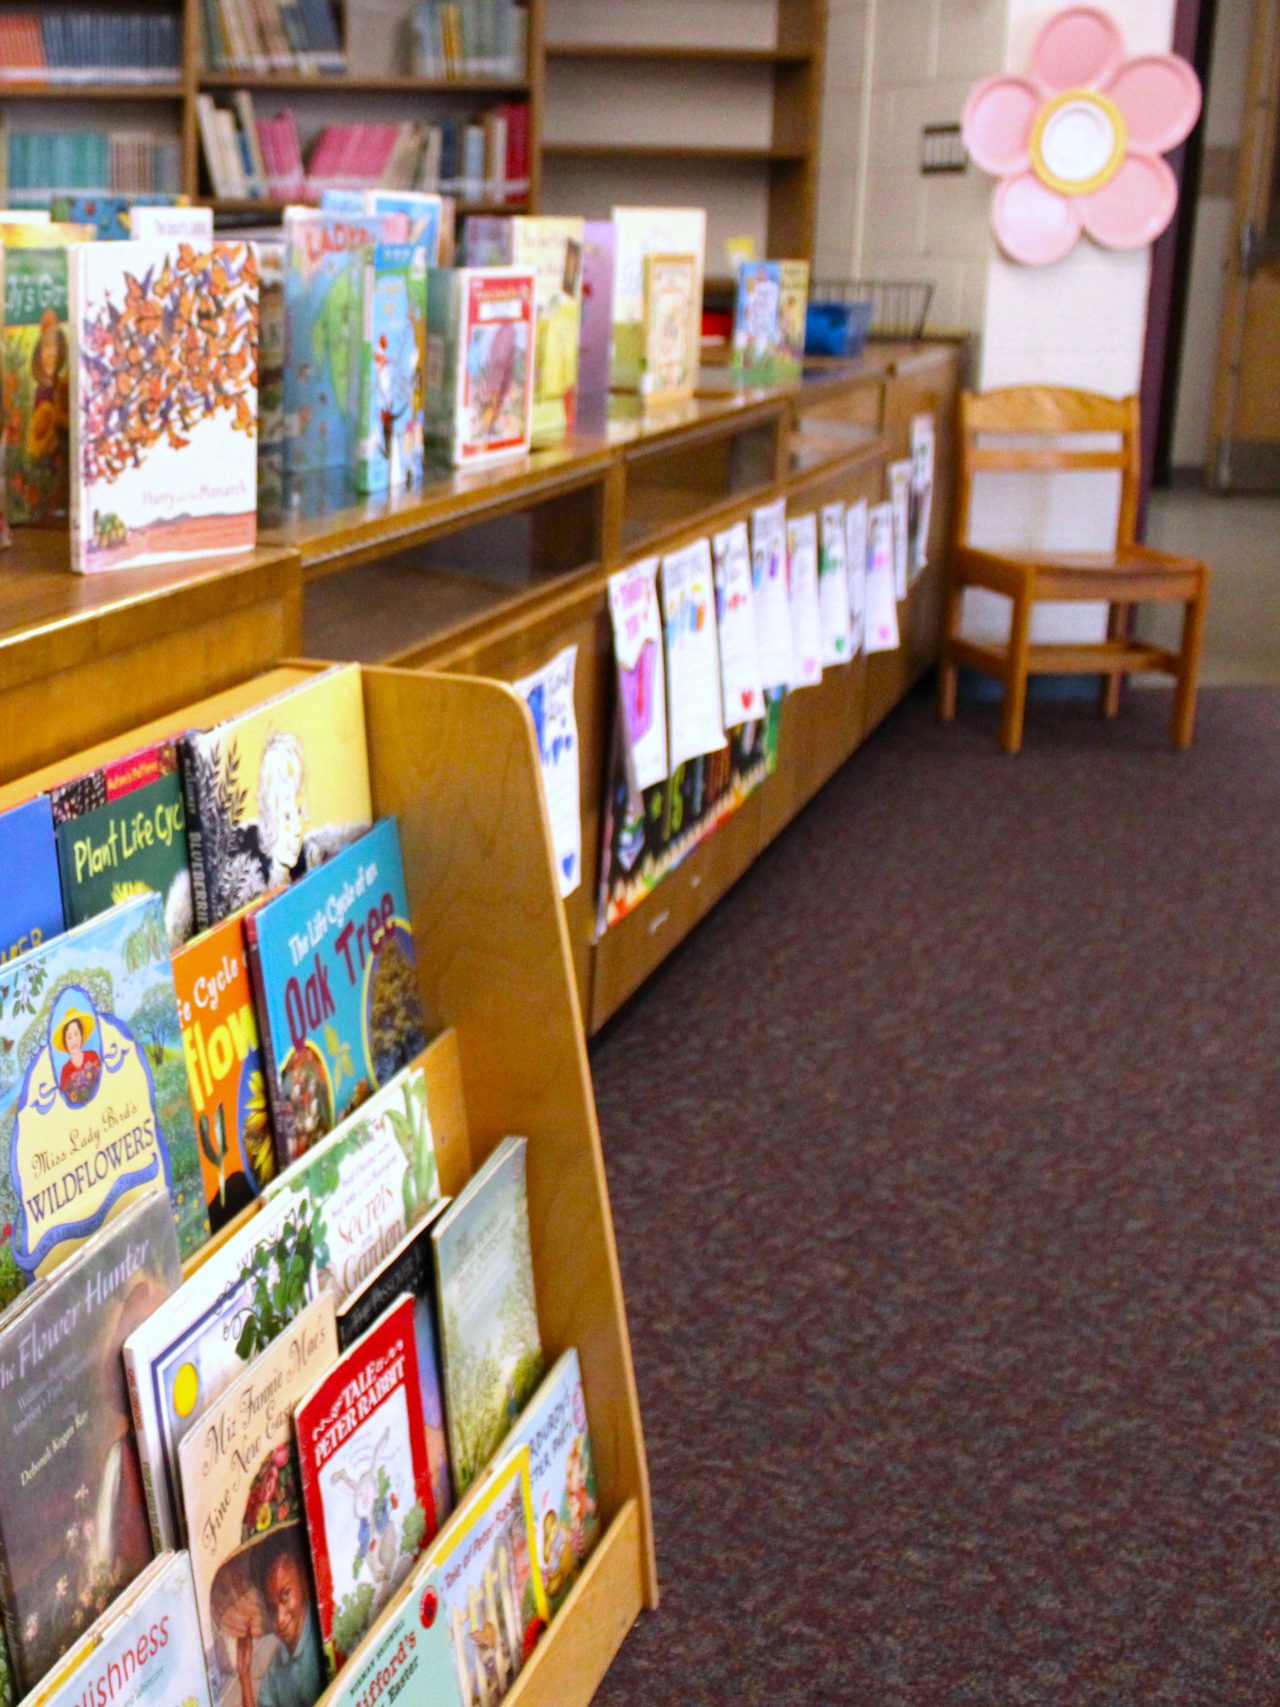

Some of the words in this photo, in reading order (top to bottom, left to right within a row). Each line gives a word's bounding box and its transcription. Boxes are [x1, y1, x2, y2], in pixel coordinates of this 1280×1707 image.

[74, 818, 118, 885] Plant
[121, 811, 154, 859] Life
[155, 792, 186, 847] Cyc
[189, 832, 209, 931] BLUEBERRIE
[287, 933, 310, 966] The
[307, 911, 329, 948] Life
[326, 882, 356, 929] Cycle
[355, 865, 366, 897] of
[194, 955, 238, 1011] Cycle
[285, 952, 336, 1050] Oak
[335, 892, 395, 987] Tree
[183, 1004, 259, 1112] Flow
[26, 1117, 155, 1224] WILDFLOWERS
[32, 1150, 67, 1180] Miss
[68, 1126, 101, 1164] Lady
[101, 1101, 139, 1137] Bird's
[19, 1301, 81, 1379] Flower
[86, 1239, 150, 1315] Hunter
[202, 1411, 237, 1477] Miz
[239, 1368, 284, 1431] Fannie
[287, 1314, 327, 1382] Mae's
[315, 1407, 357, 1468] PETER
[357, 1355, 405, 1420] RABBIT
[342, 1361, 377, 1408] TALE
[21, 1446, 52, 1487] Deborah
[52, 1424, 75, 1455] Kogan
[74, 1410, 89, 1430] Ray
[229, 1434, 262, 1492] New
[202, 1489, 232, 1557] Fine
[349, 1658, 375, 1698] NORMAN
[356, 1630, 417, 1707] ifford's
[387, 1655, 419, 1704] Easter
